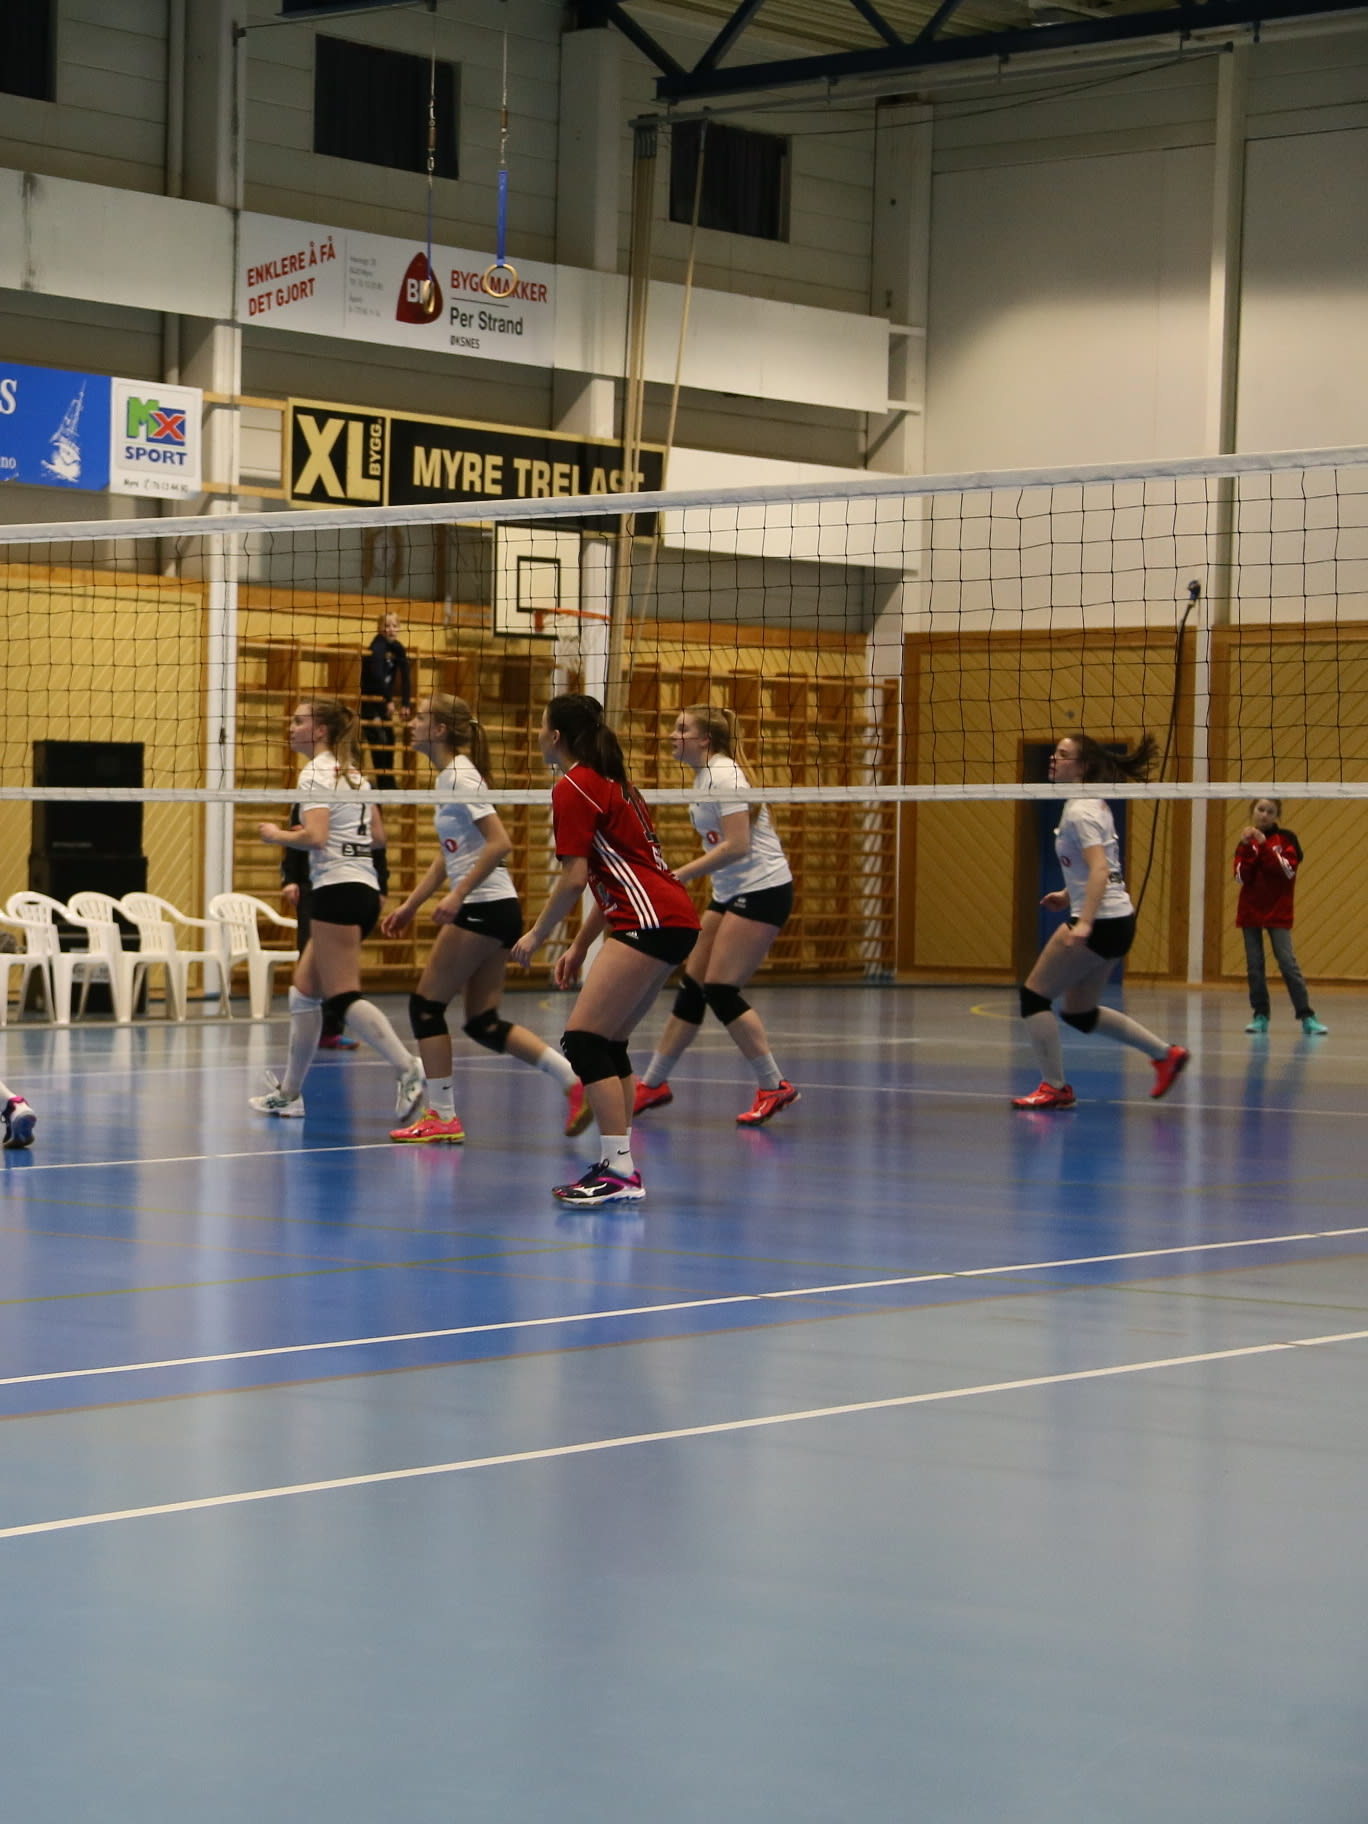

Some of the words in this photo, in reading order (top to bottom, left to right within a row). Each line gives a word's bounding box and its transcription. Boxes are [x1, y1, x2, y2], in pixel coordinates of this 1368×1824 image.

[247, 251, 306, 287] ENKLERE
[309, 241, 317, 267] Å
[320, 235, 336, 264] FÅ
[248, 292, 273, 316] DET
[276, 277, 316, 306] GJORT
[450, 307, 474, 328] Per
[478, 310, 524, 336] Strand
[450, 335, 480, 349] ØKSNES
[124, 445, 188, 466] SPORT
[293, 414, 381, 501] XL
[367, 418, 382, 476] BYGG
[412, 445, 503, 495] MYRE
